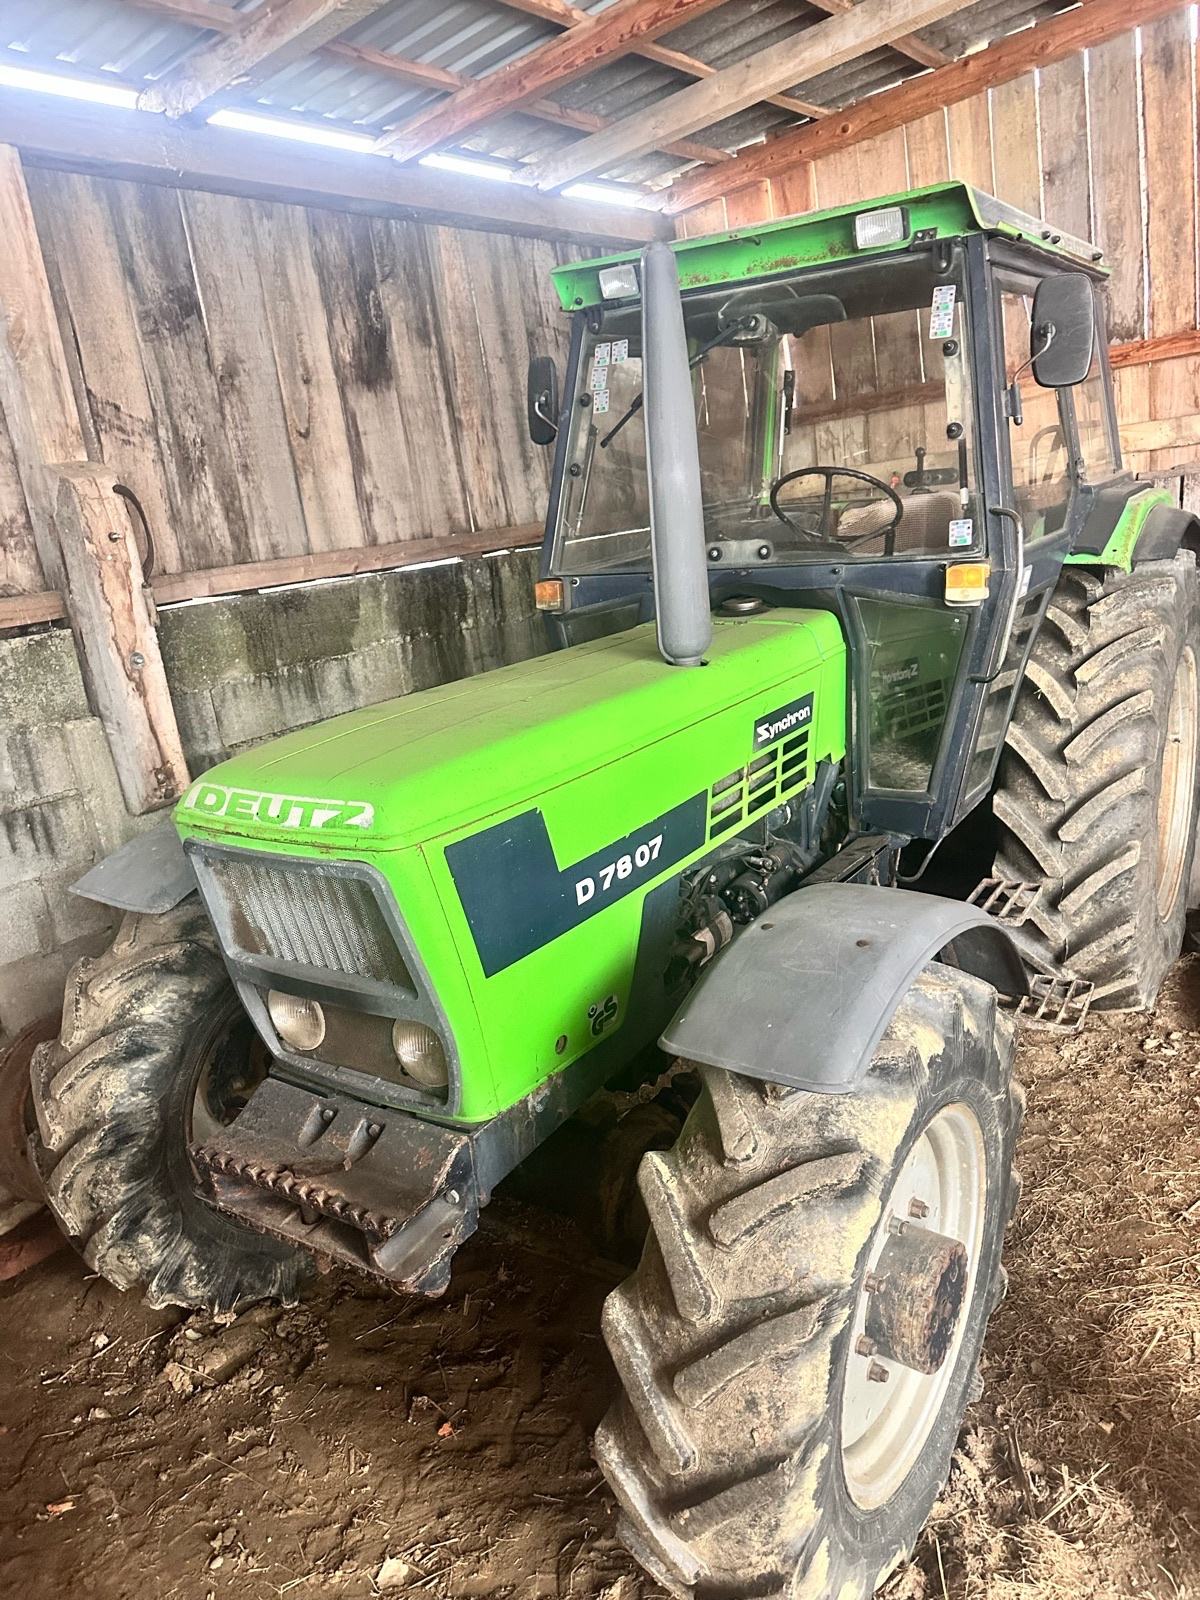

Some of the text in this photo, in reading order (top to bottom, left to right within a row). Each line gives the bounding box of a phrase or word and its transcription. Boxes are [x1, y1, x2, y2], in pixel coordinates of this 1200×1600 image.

[756, 706, 811, 743] Synchron
[194, 785, 366, 829] DEUTZ
[575, 877, 595, 906] D
